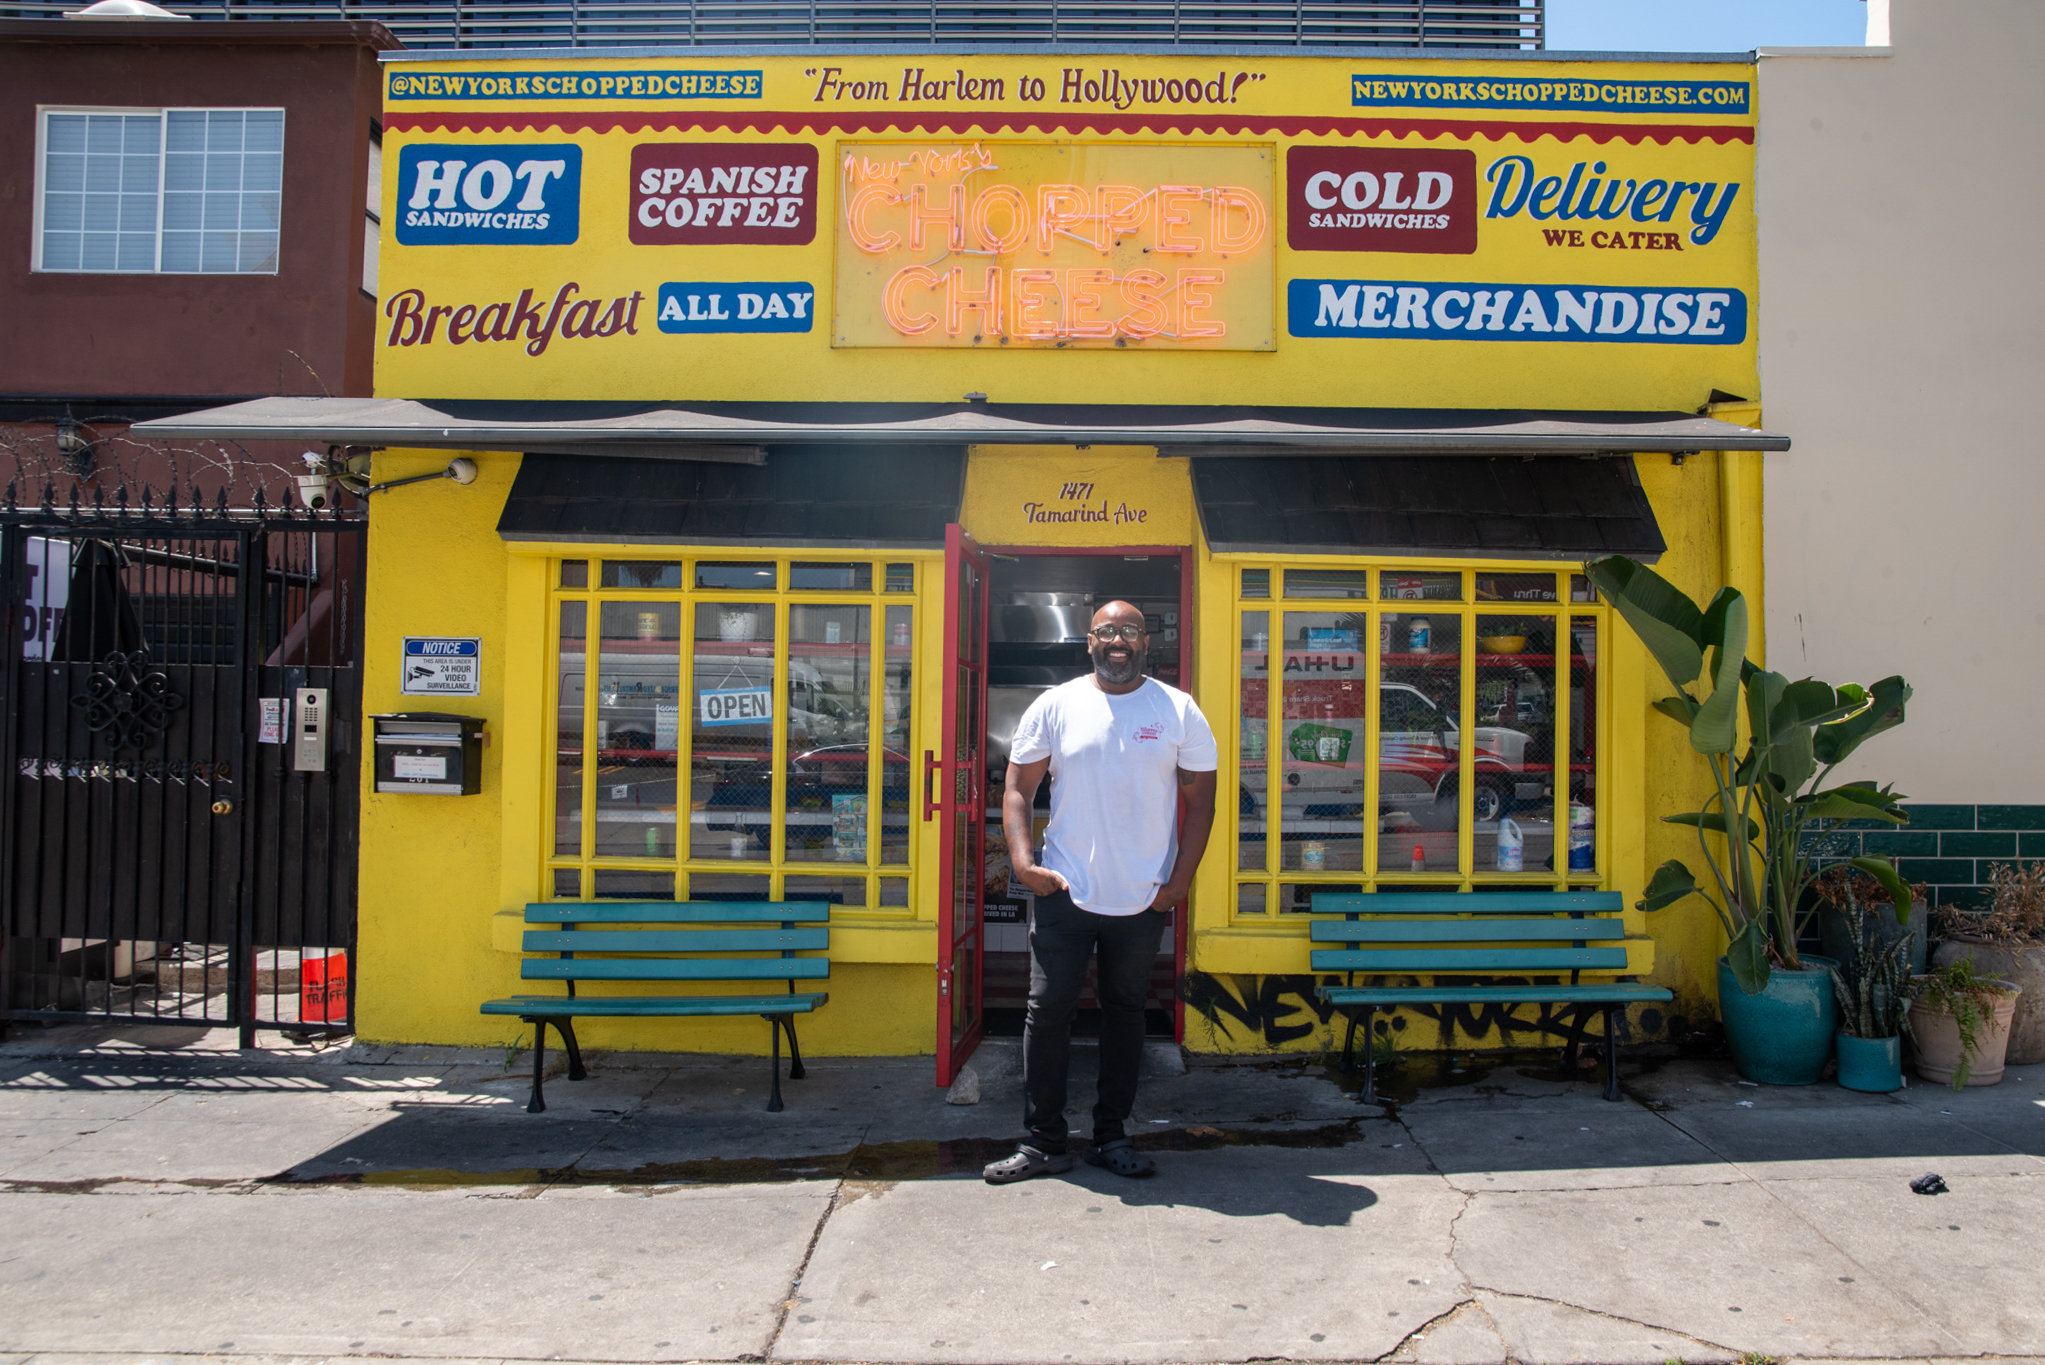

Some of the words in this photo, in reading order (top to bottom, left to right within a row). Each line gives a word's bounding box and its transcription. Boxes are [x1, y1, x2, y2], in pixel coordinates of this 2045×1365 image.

[390, 74, 760, 97] @NEWYORKSCHOPPEDCHEESE
[898, 68, 1005, 102] Harlem
[1018, 74, 1046, 102] to
[1353, 80, 1746, 105] NEWYORKSCHOPPEDCHEESE.COM
[639, 165, 808, 195] SPANISH
[844, 155, 901, 183] New
[408, 160, 566, 211] HOT
[1304, 170, 1453, 211] COLD
[637, 197, 804, 229] COFFEE
[1484, 154, 1740, 246] Delivery
[405, 211, 550, 230] SANDWICHES
[847, 183, 1267, 254] CHOPPED
[1308, 212, 1451, 230] SANDWICHES
[1542, 229, 1585, 248] WE
[1591, 230, 1684, 251] CATER
[658, 294, 729, 321] ALL
[736, 292, 813, 320] DAY
[882, 265, 1226, 339] CHEESE
[1314, 284, 1731, 336] MERCHANDISE
[385, 282, 646, 357] Breakfast
[1058, 482, 1095, 500] 1471
[1022, 500, 1110, 523] Tamarind
[1112, 502, 1148, 525] Ave
[421, 642, 461, 654] NOTICE
[440, 664, 449, 673] 24
[451, 665, 472, 673] HOUR
[445, 674, 467, 682] VIDEO
[427, 682, 471, 690] SURVEILLANCE
[707, 692, 766, 720] OPEN
